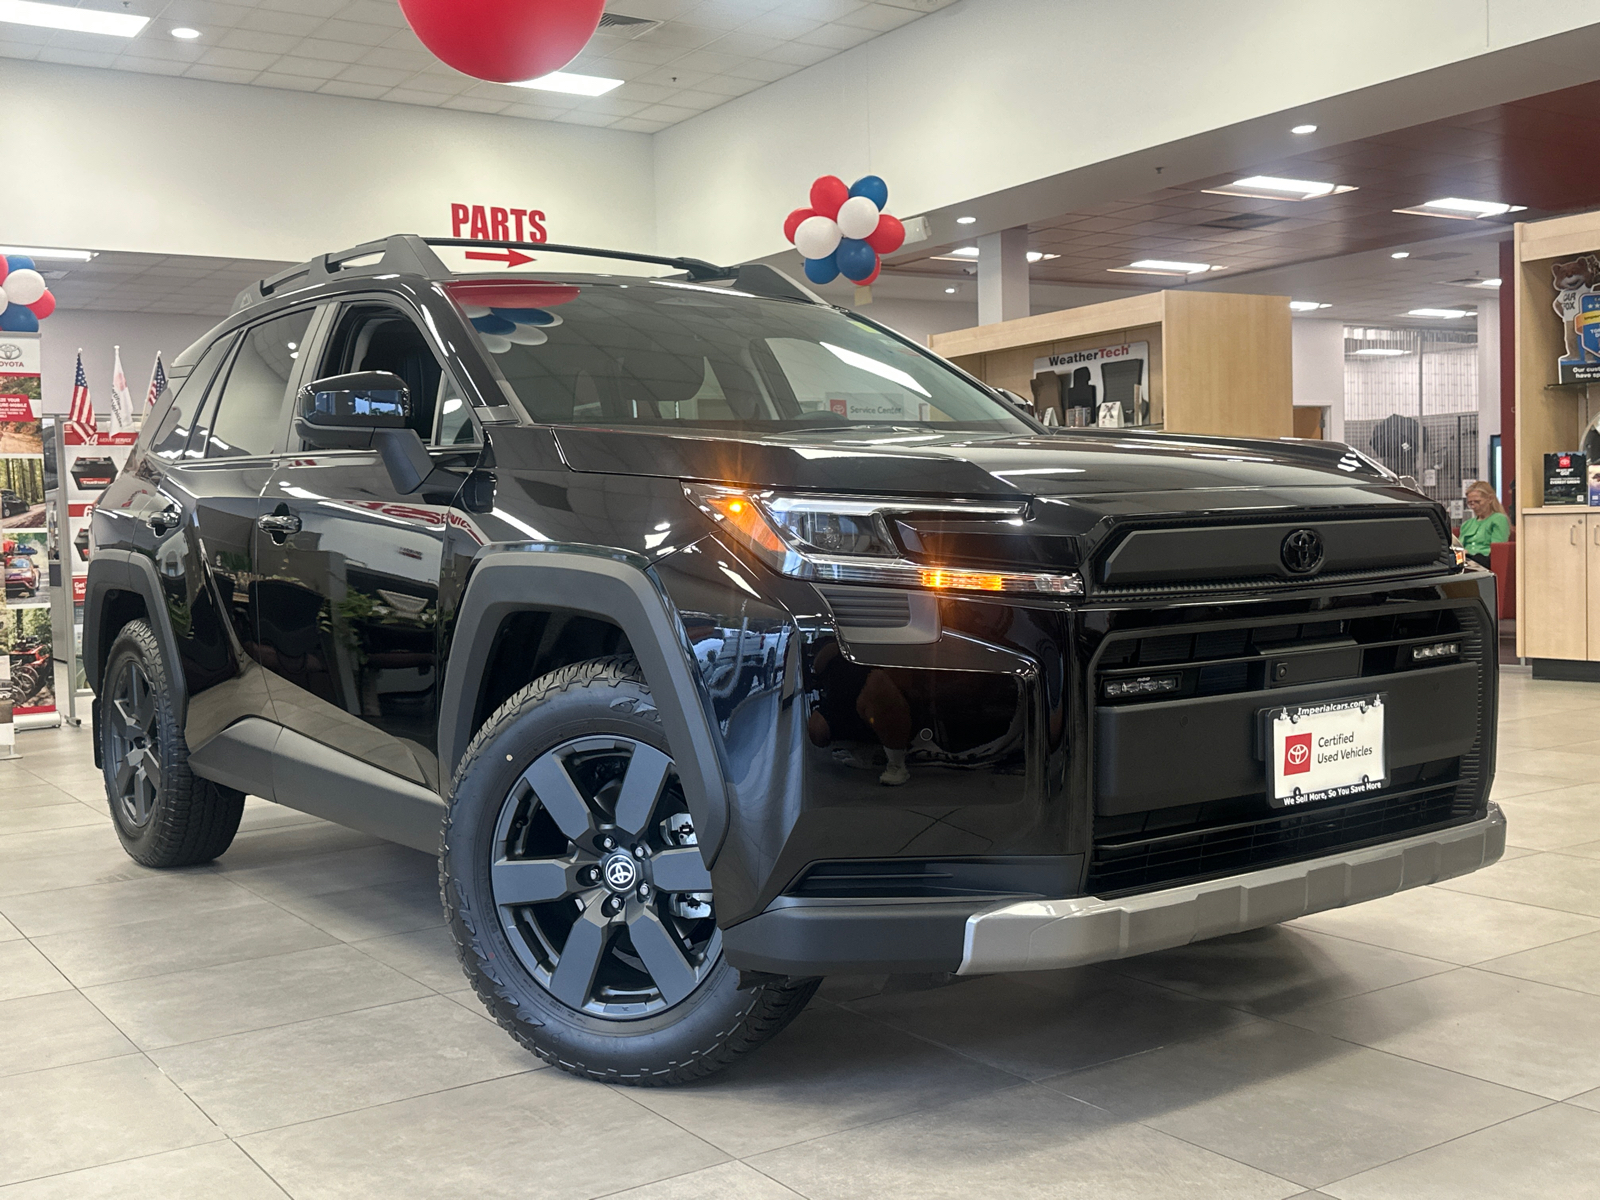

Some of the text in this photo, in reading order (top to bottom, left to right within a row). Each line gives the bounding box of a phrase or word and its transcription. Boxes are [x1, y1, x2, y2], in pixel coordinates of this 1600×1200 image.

[451, 203, 547, 244] PARTS
[1049, 345, 1130, 367] WeatherTech
[850, 405, 902, 414] Service Center
[1297, 700, 1366, 716] Imperialcars.com
[1318, 731, 1354, 748] Certified
[1317, 746, 1373, 764] Used Vehicles
[1284, 797, 1295, 806] We
[1295, 795, 1308, 804] Sell
[1328, 789, 1337, 797] So
[1338, 787, 1350, 796] You
[1351, 785, 1365, 794] Save
[1366, 781, 1382, 790] More
